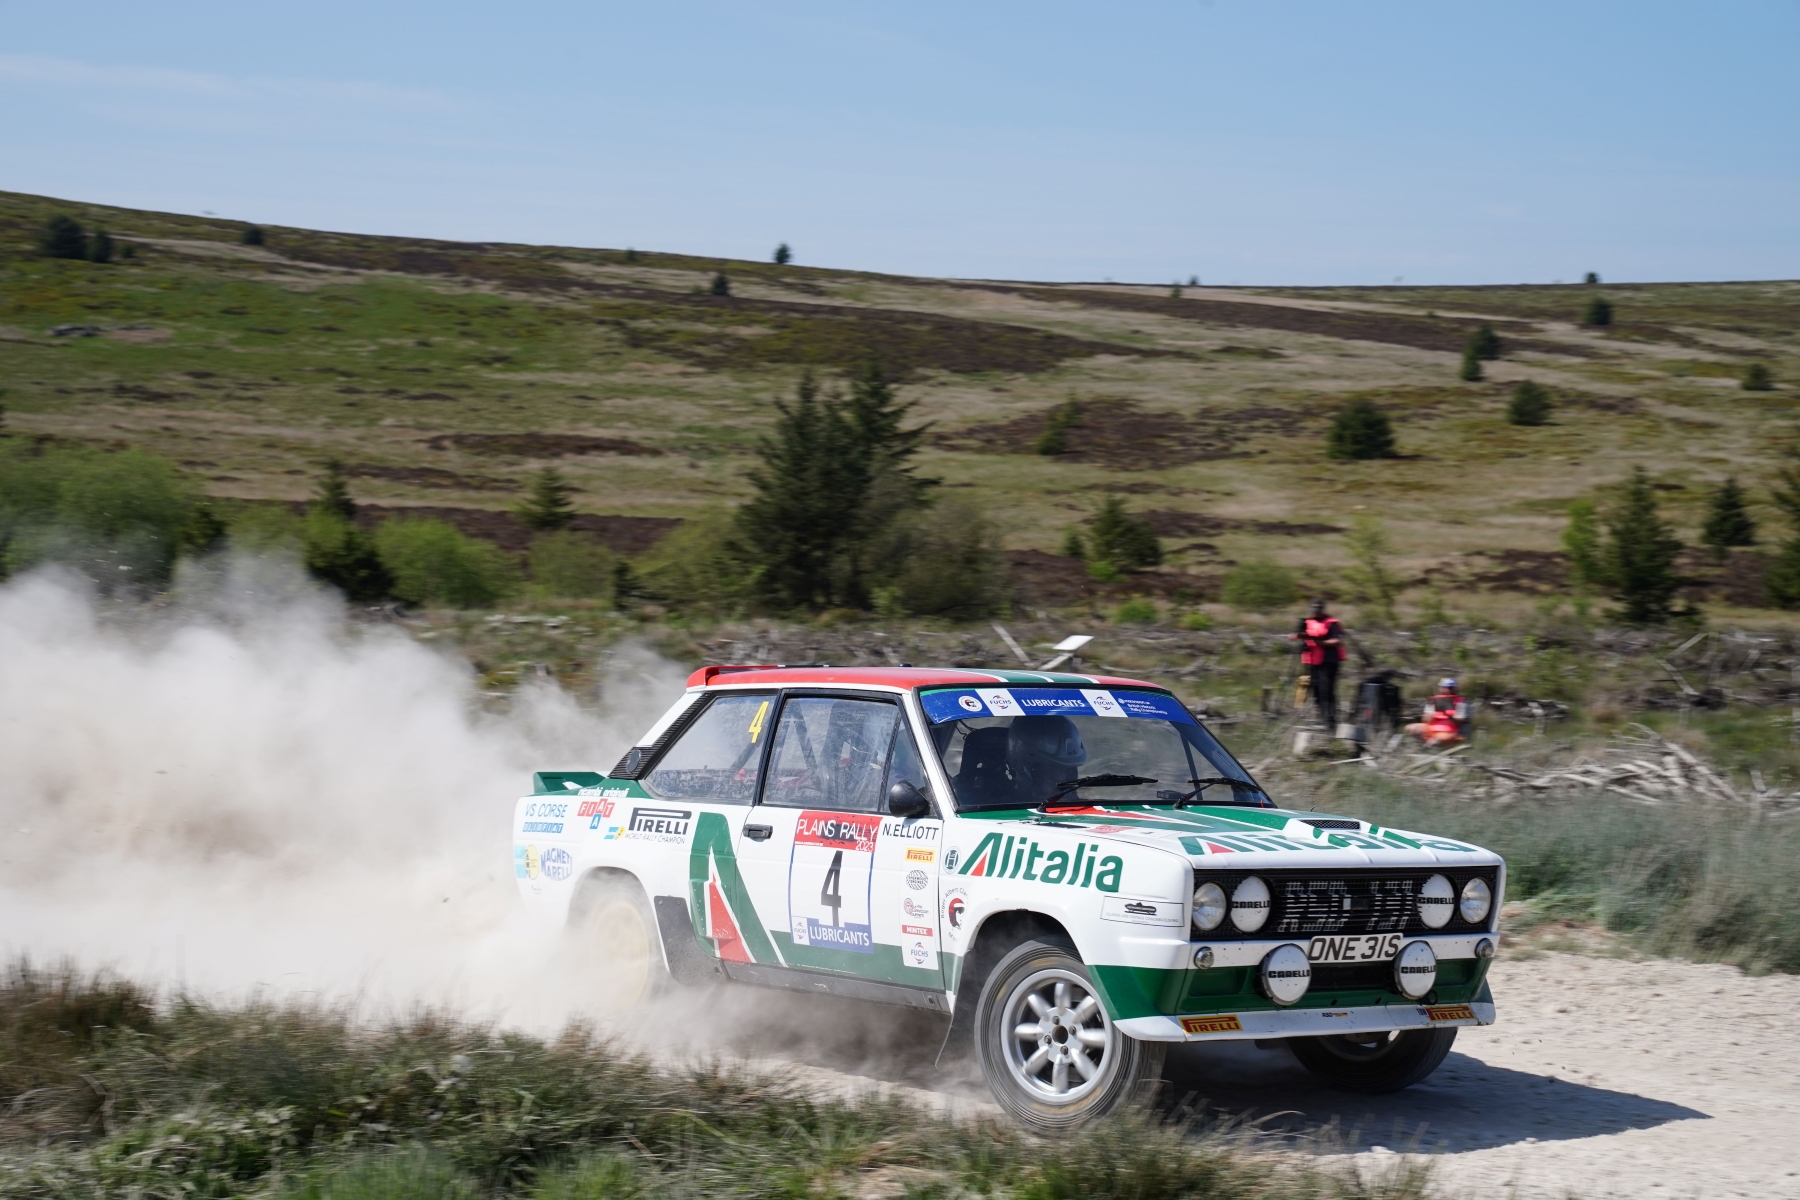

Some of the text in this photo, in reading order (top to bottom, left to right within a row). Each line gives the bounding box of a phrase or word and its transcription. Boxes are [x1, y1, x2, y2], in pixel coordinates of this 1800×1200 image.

[1021, 699, 1086, 708] LUBRICANTS
[748, 701, 769, 743] 4
[525, 803, 568, 817] VS CORSE
[577, 799, 615, 817] FIAT
[628, 807, 692, 835] PIRELLI
[797, 818, 879, 841] PLAINS RALLY
[882, 823, 940, 840] N.ELLIOTT
[855, 840, 874, 852] 2023
[907, 850, 933, 861] PIRELLI
[957, 832, 1123, 893] Alitalia
[821, 850, 843, 927] 4
[809, 926, 870, 947] LUBRICANTS
[906, 926, 928, 936] MINTEX
[910, 949, 929, 958] FUCHS
[1308, 937, 1361, 960] ONE
[1425, 1005, 1475, 1021] PIRELLI
[1181, 1016, 1241, 1033] PIRELLI
